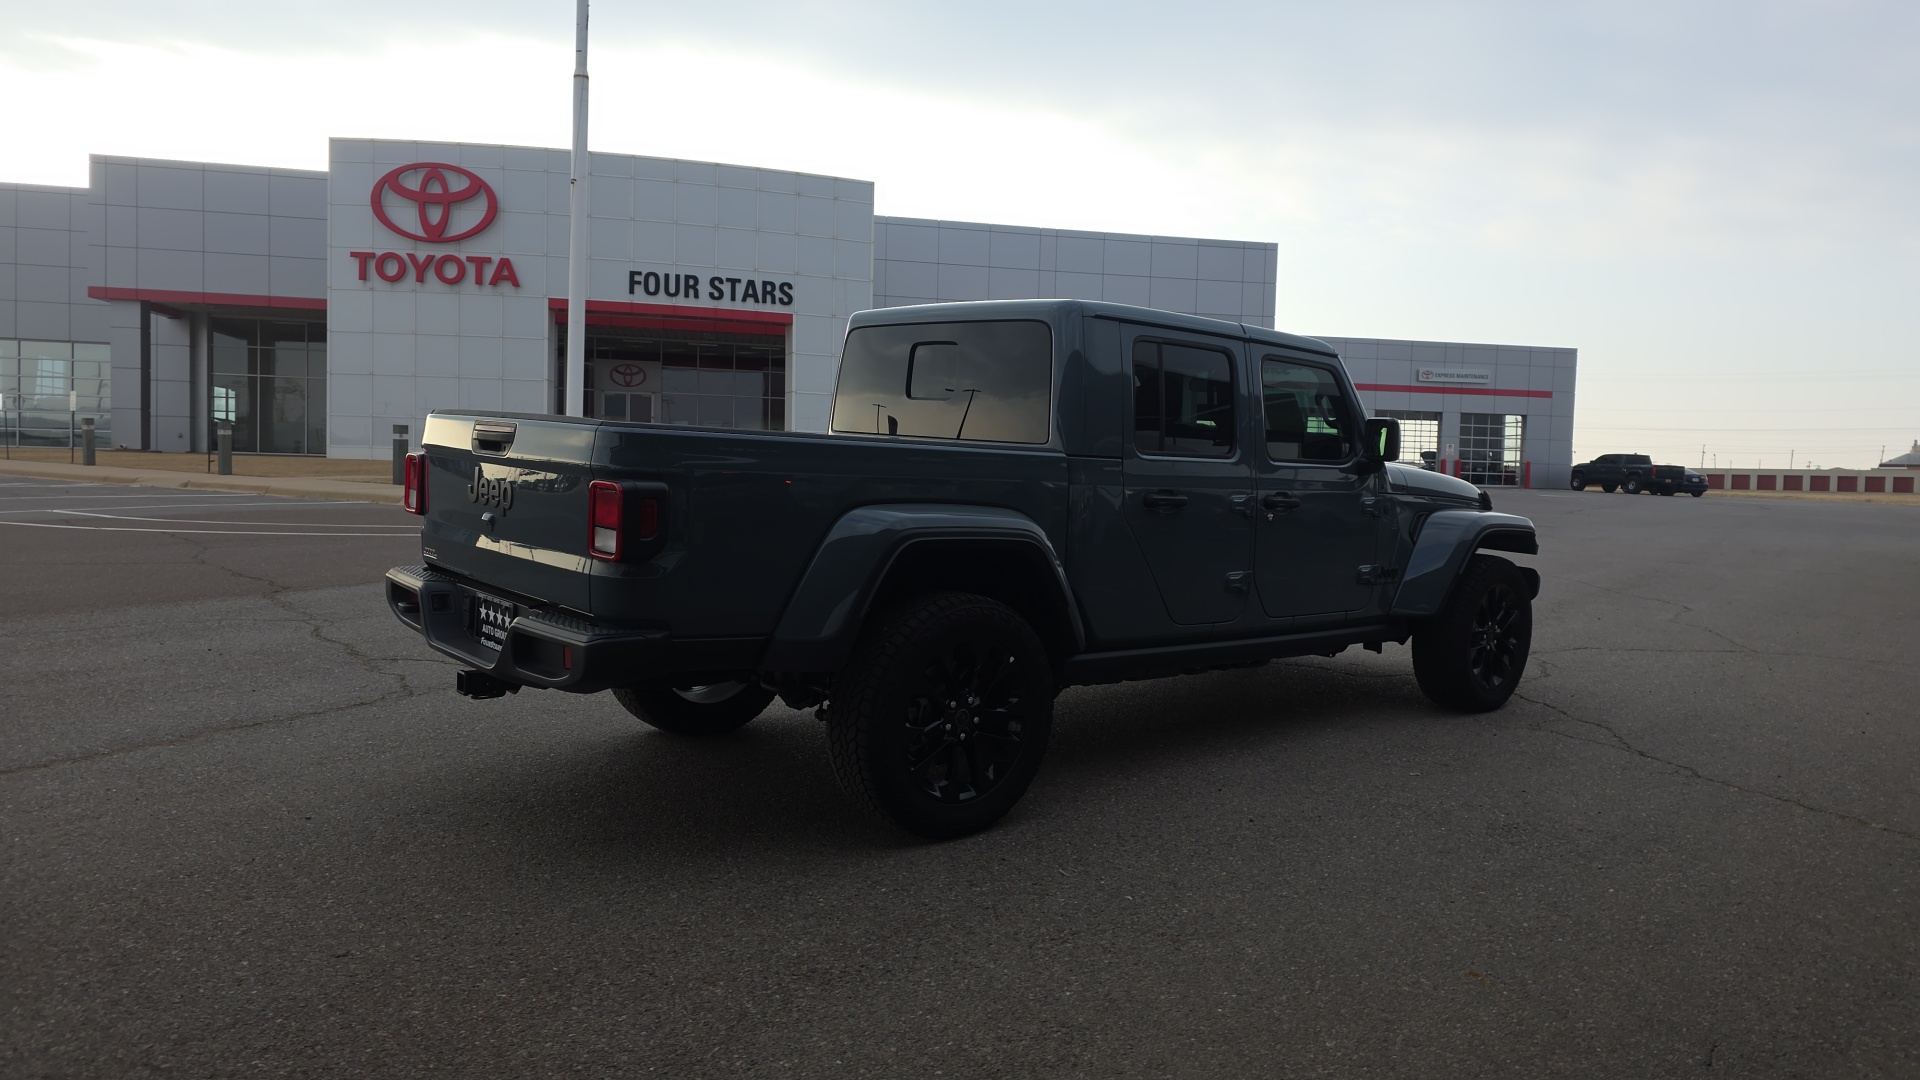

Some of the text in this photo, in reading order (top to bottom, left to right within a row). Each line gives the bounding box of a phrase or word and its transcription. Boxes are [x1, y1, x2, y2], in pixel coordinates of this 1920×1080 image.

[349, 250, 521, 288] TOYOTA
[628, 270, 794, 306] FOUR STARS
[467, 466, 515, 518] Jeep
[481, 623, 508, 640] AUTO GROU
